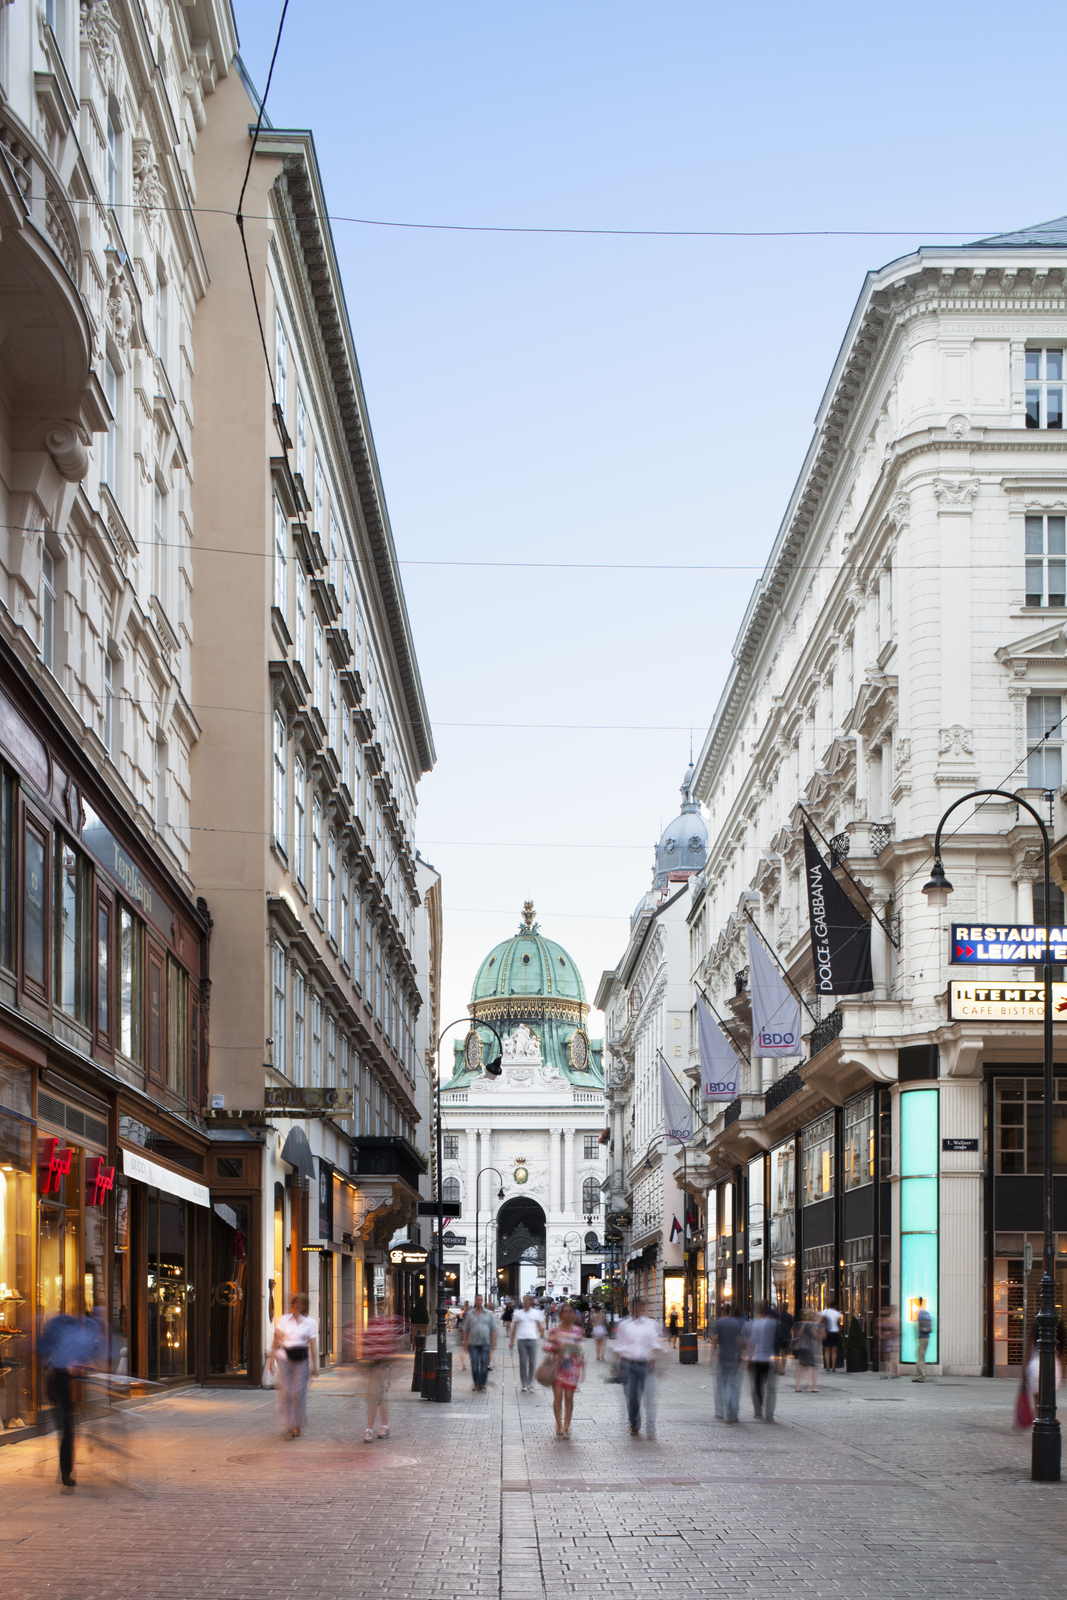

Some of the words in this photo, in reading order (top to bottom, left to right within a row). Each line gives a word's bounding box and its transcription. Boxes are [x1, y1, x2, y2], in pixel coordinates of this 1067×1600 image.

[113, 841, 152, 912] Topkapi
[810, 864, 828, 938] GABBANA
[817, 945, 833, 991] DOLCE
[957, 990, 972, 1000] IL
[762, 1033, 795, 1045] BDO
[709, 1082, 736, 1092] BDO
[268, 1090, 350, 1105] GUCCI
[671, 1129, 691, 1138] BDO
[131, 1158, 147, 1175] GUCCI
[193, 1186, 205, 1200] GUCCI
